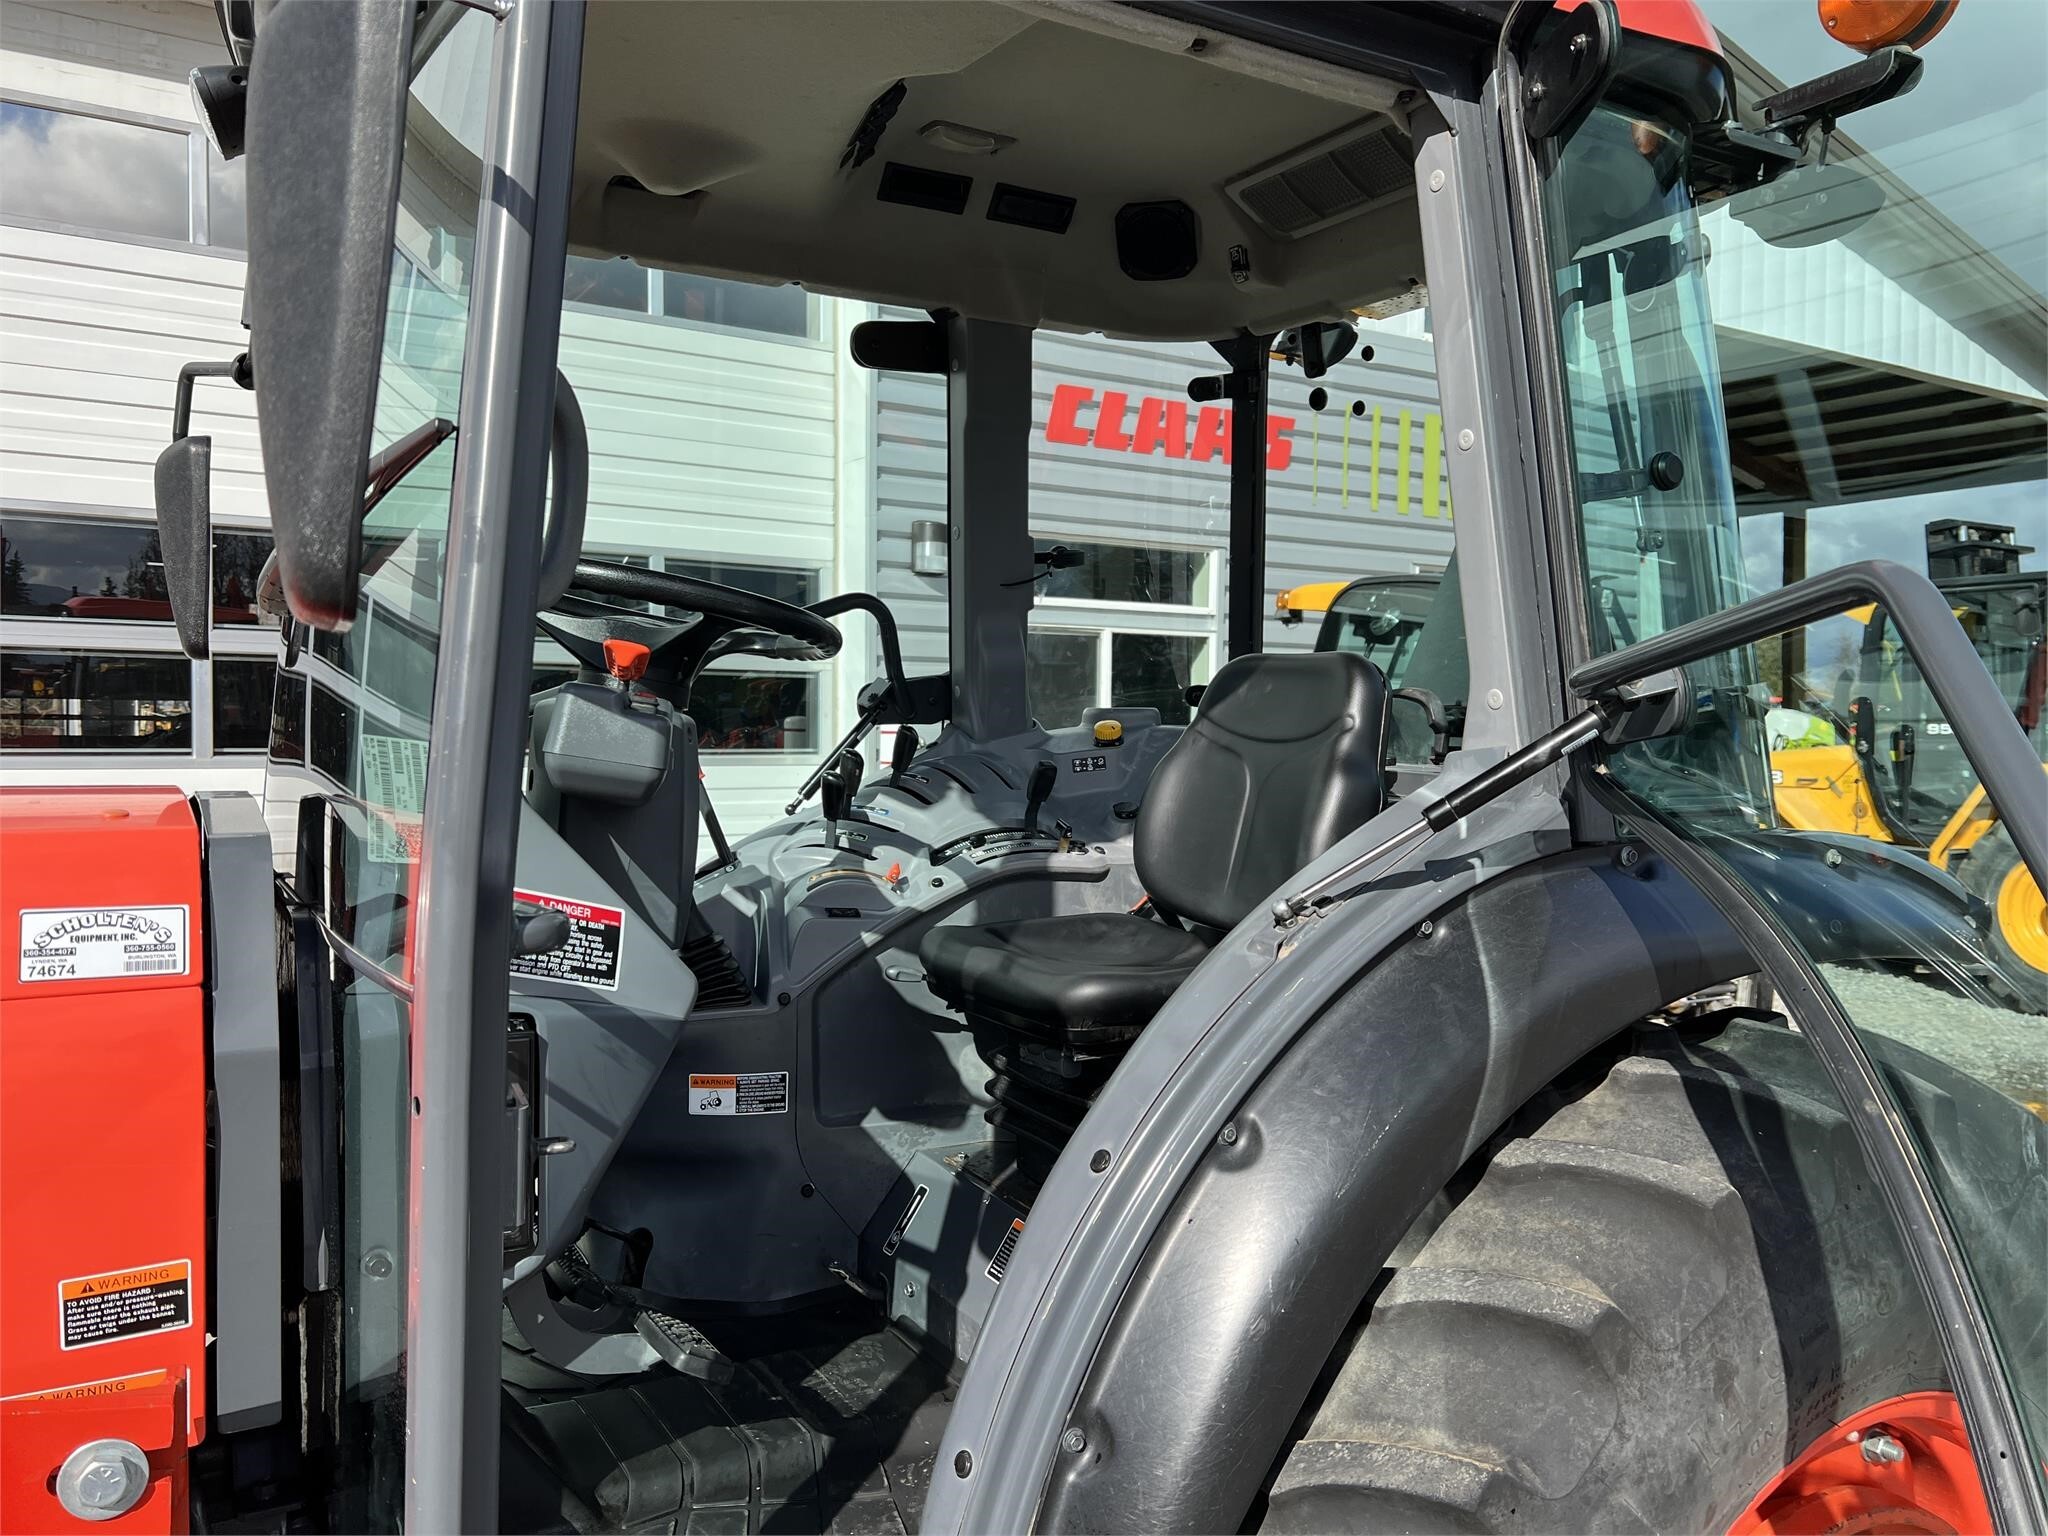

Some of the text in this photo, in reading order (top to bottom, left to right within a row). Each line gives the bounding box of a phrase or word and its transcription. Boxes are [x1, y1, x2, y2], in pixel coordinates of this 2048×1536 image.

[1046, 384, 1296, 471] CLAAS
[550, 901, 591, 918] DANGER
[33, 911, 172, 949] SCHOLTEN'S
[588, 921, 605, 930] DEATH
[70, 933, 138, 943] EQUIPMENT, INC.
[24, 948, 76, 957] 360-354-4071
[124, 943, 175, 953] 360-755-0560
[27, 964, 76, 977] 74674
[548, 962, 560, 970] PTO
[98, 1269, 170, 1290] WARNING
[79, 1296, 102, 1306] AVOID
[104, 1293, 120, 1301] FIRE
[132, 1301, 156, 1309] nothing
[67, 1307, 85, 1315] After
[101, 1300, 124, 1309] and/or
[133, 1306, 159, 1316] exhaust
[118, 1317, 137, 1325] under
[152, 1310, 175, 1319] bonnet
[84, 1330, 103, 1338] cause
[53, 1382, 126, 1400] WARNING
